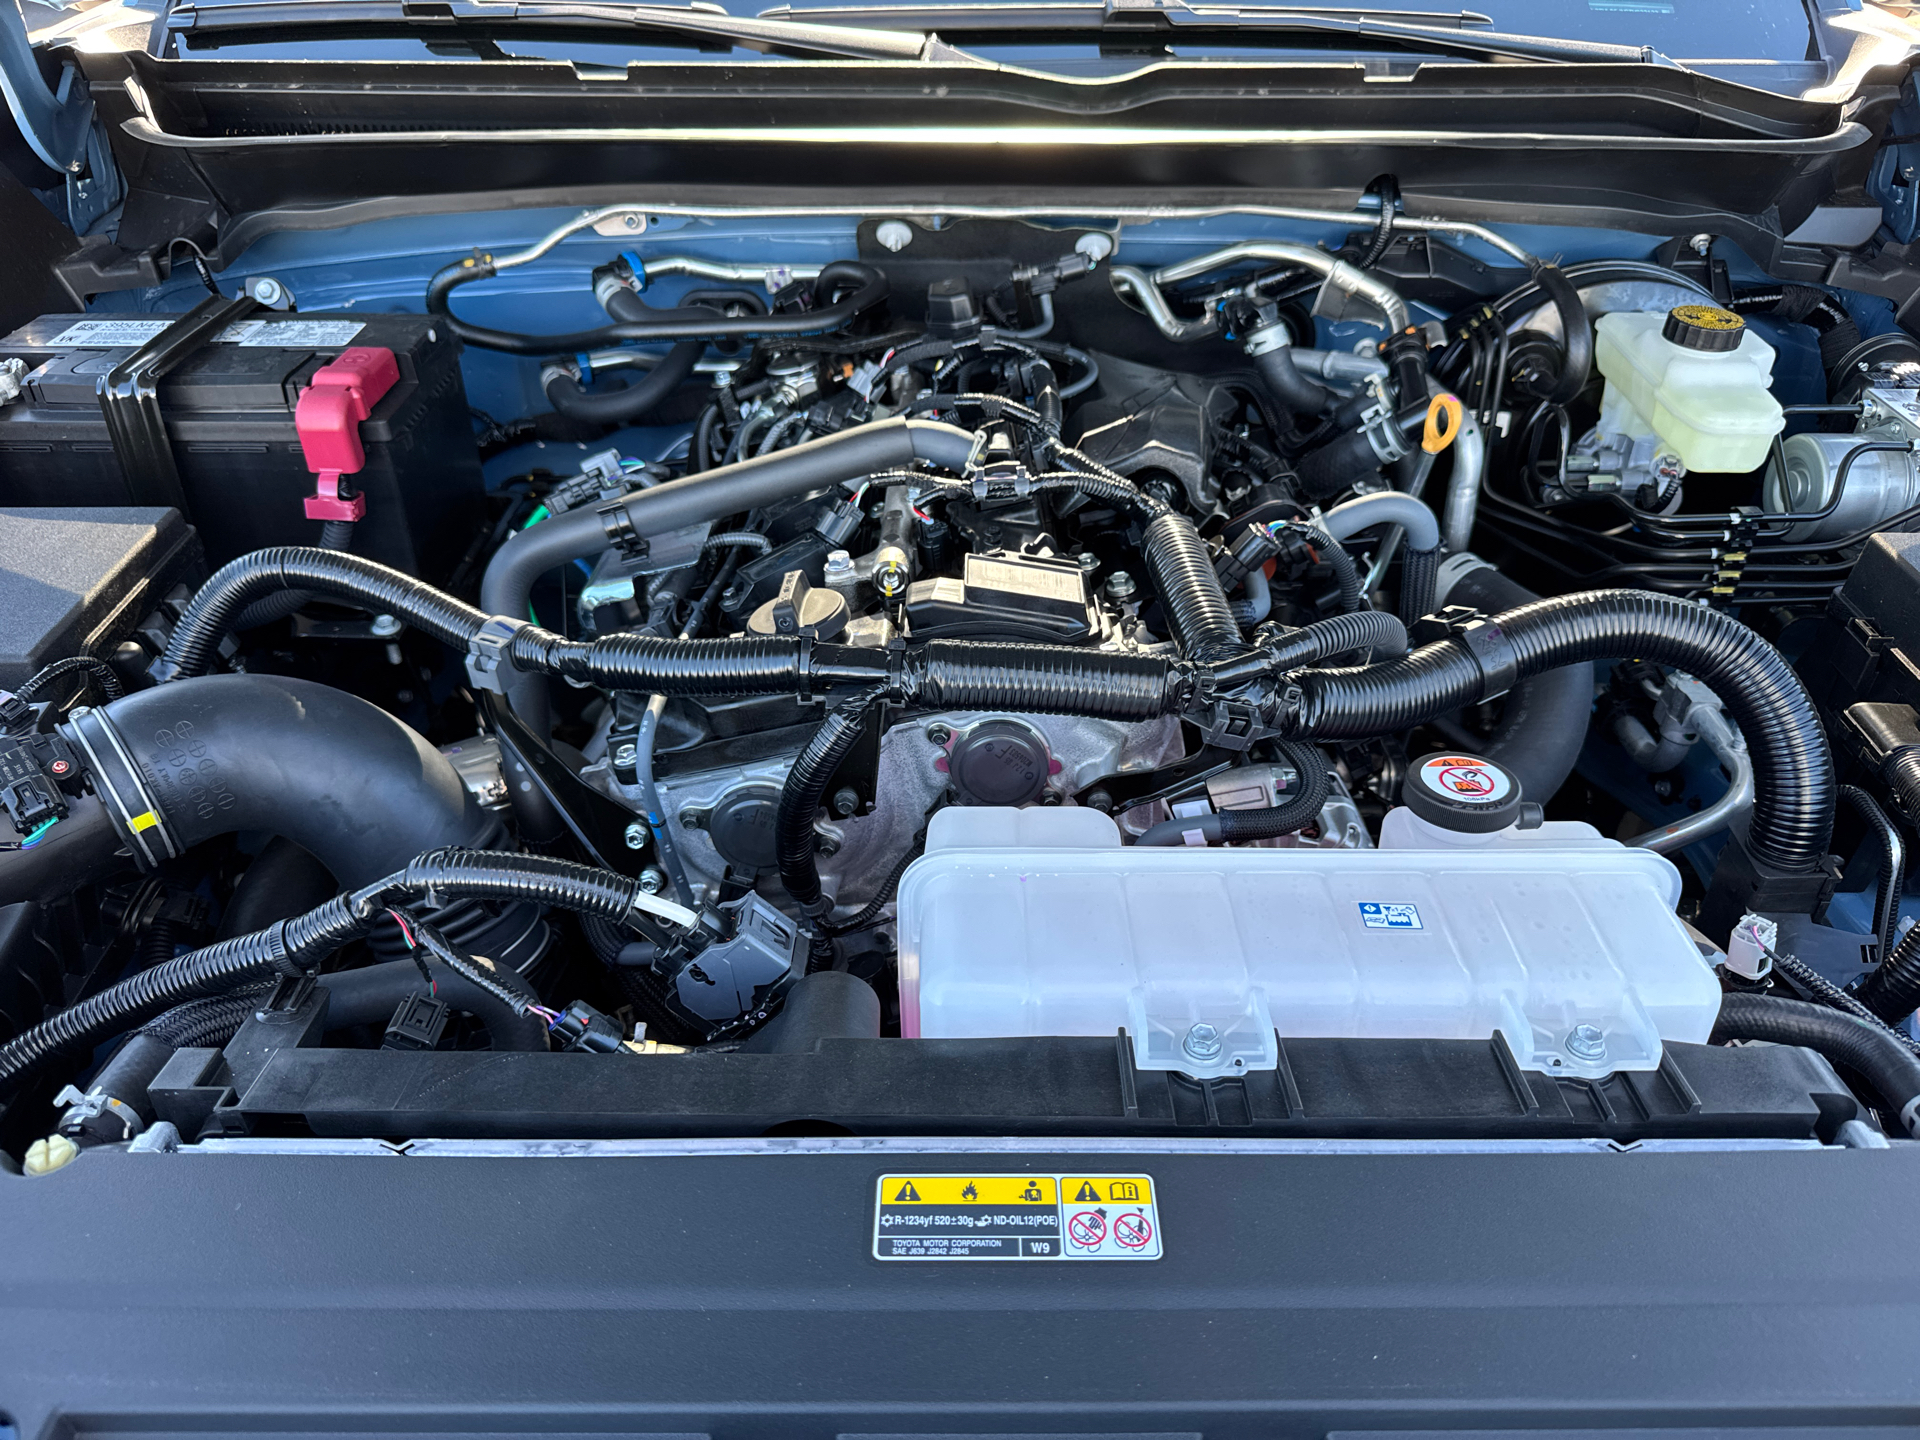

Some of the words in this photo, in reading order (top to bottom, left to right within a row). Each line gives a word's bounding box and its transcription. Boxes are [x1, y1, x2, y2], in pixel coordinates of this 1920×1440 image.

[894, 1215, 934, 1228] R-1234yf
[934, 1215, 974, 1228] 520±30g
[993, 1215, 1058, 1228] ND-OIL12(POE)
[892, 1239, 920, 1247] TOYOTA
[923, 1239, 949, 1247] MOTOR
[951, 1239, 1002, 1247] CORPORATION
[1030, 1241, 1051, 1254] W9
[892, 1247, 907, 1255] SAE
[908, 1247, 926, 1255] J639
[927, 1247, 948, 1255] J2842
[949, 1247, 970, 1255] J2845
